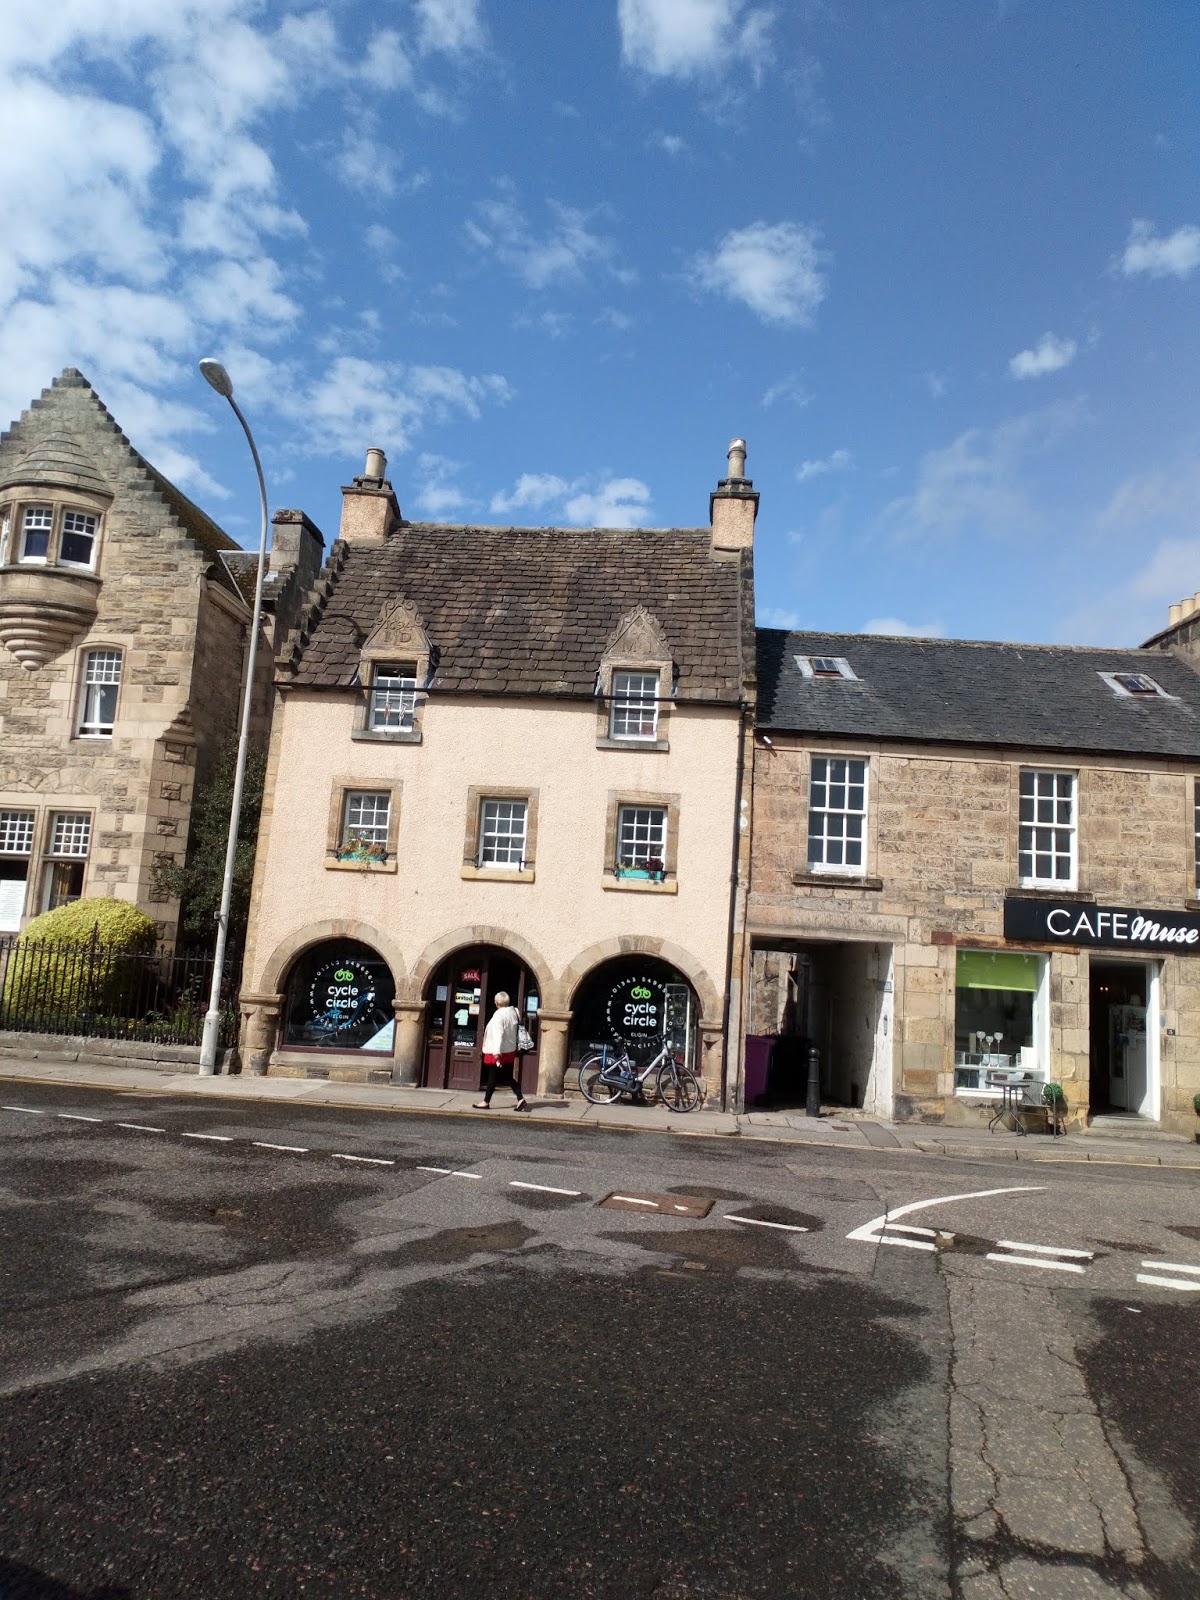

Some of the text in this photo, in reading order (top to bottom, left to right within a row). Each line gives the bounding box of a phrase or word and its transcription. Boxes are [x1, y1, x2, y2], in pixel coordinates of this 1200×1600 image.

[1047, 909, 1199, 943] CAFE Muse
[327, 984, 359, 997] cycle
[325, 997, 359, 1008] circle
[624, 1002, 657, 1015] cycle
[623, 1014, 657, 1027] circle
